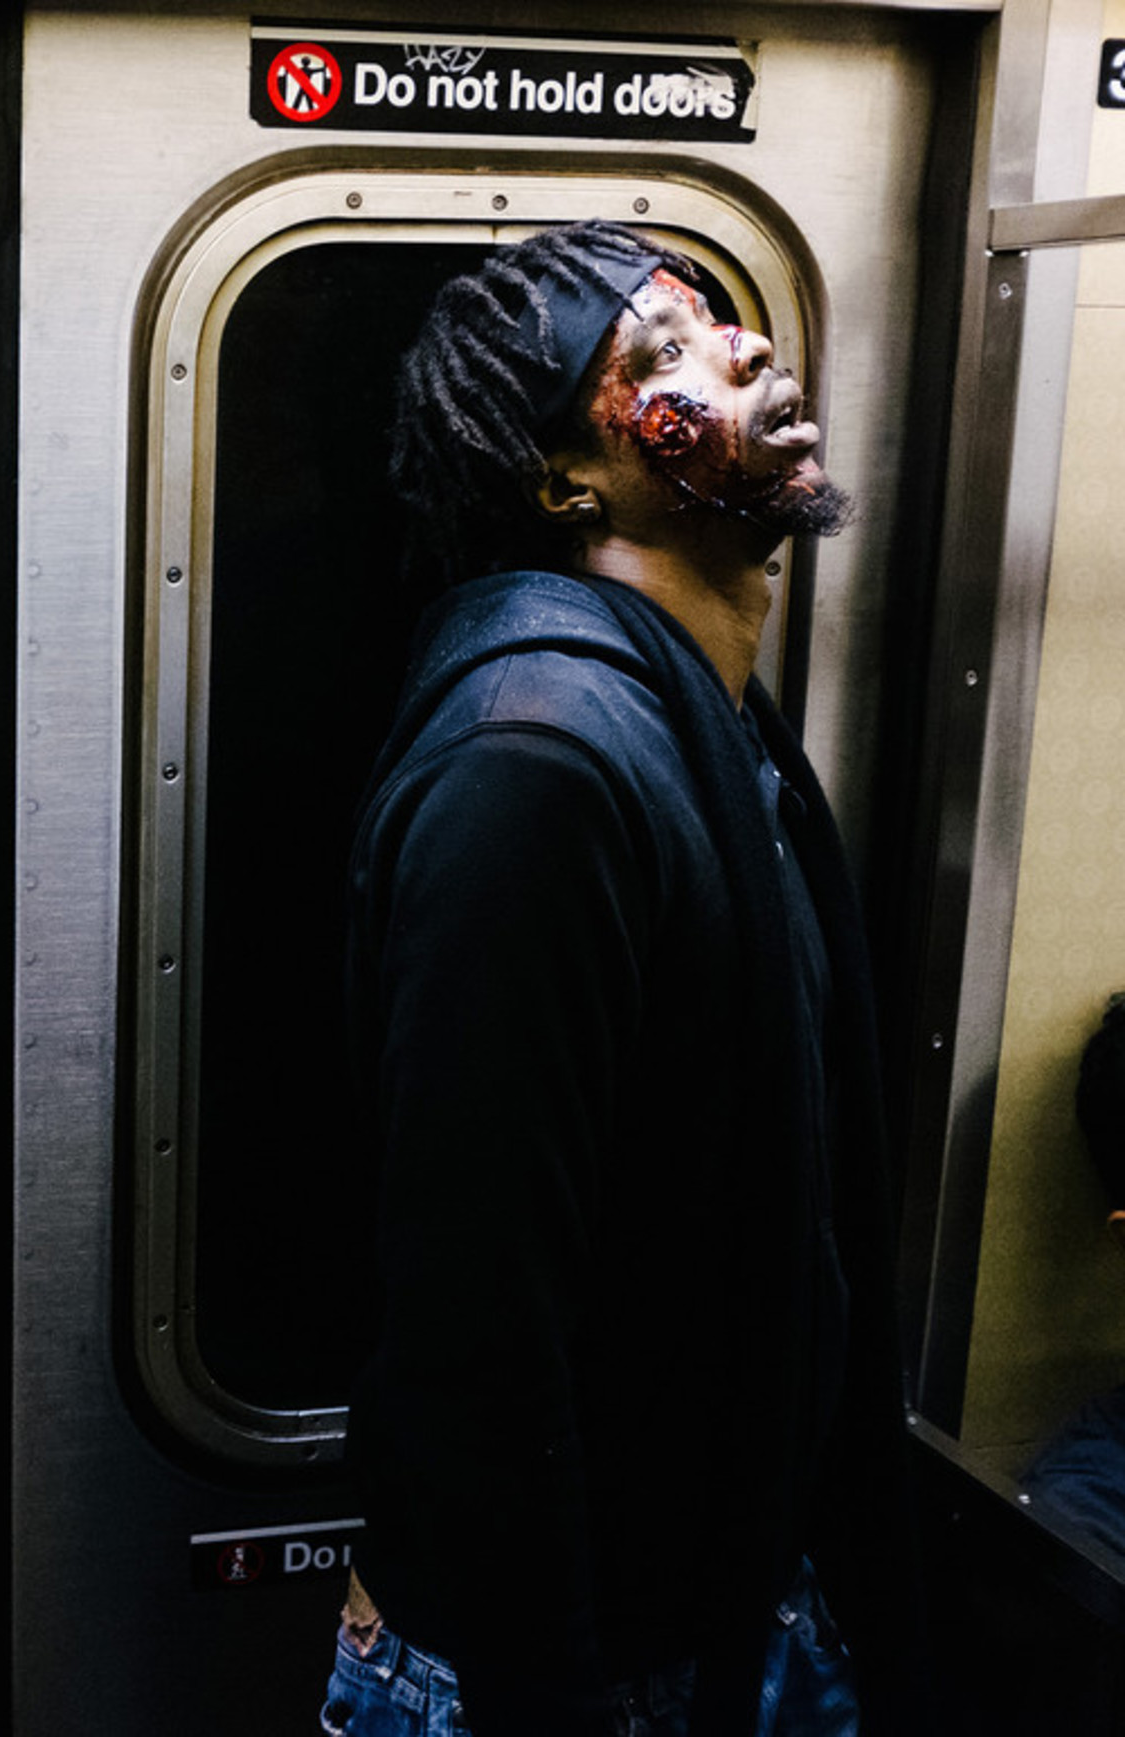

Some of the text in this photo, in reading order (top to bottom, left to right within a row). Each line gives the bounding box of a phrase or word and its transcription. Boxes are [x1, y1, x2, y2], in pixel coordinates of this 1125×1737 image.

[354, 62, 737, 120] Do not hold doors
[284, 1542, 336, 1573] Do
